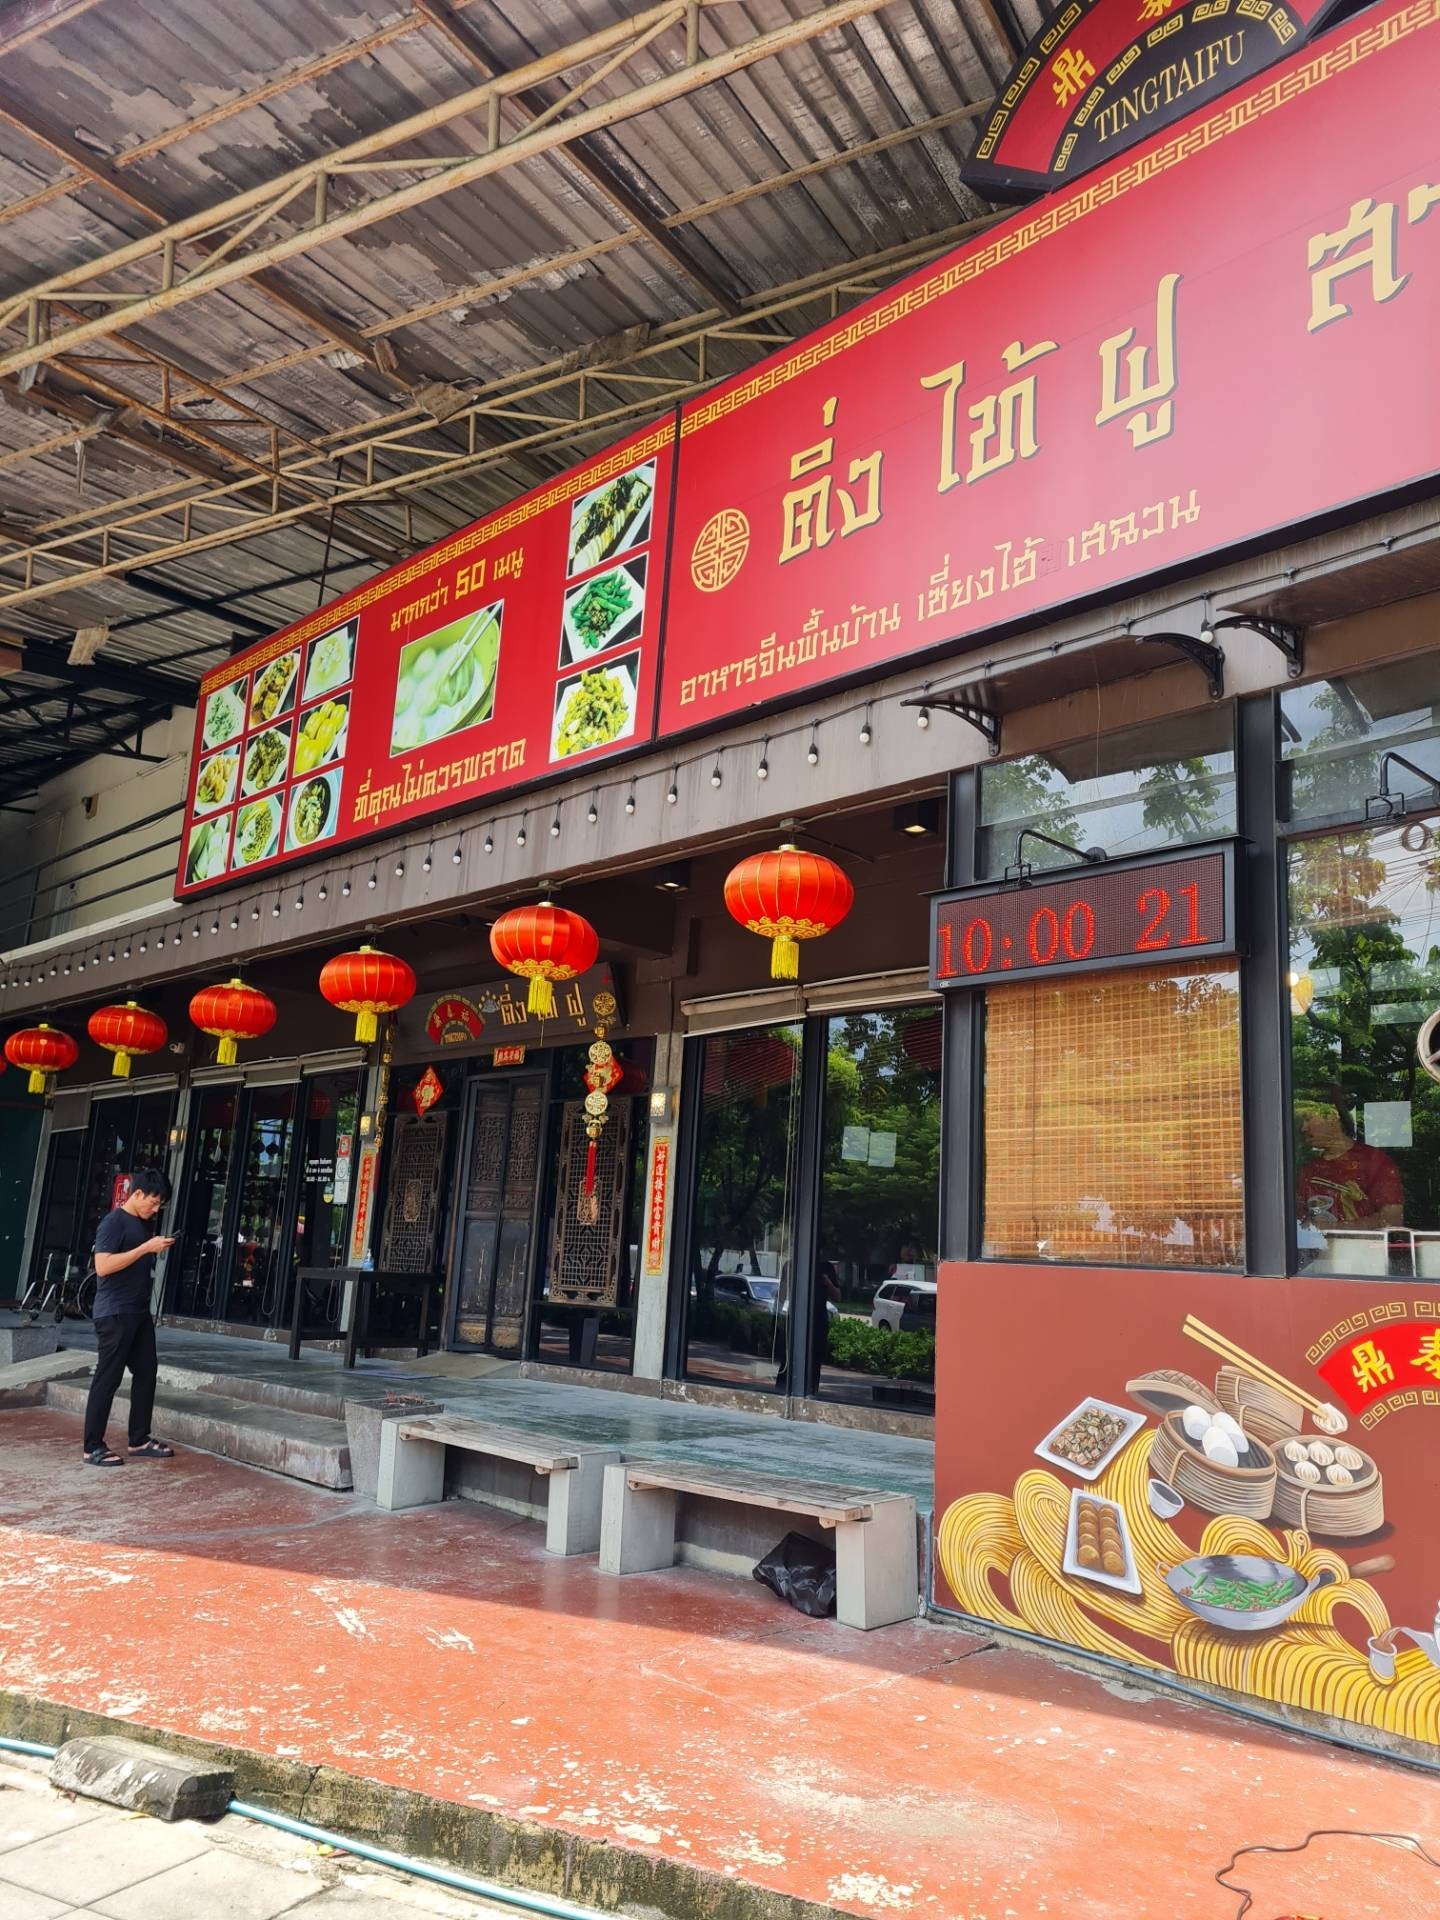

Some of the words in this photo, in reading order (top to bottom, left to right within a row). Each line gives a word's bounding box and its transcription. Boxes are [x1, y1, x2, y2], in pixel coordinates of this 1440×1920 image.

[1093, 30, 1246, 143] TINGTAIFU
[778, 396, 885, 565] ติ่ง
[920, 339, 1058, 495] ไท้
[390, 577, 449, 632] มากกว่า
[455, 558, 487, 600] 50
[492, 547, 524, 581] เมนู
[679, 601, 901, 706] อาหารจีนพื้นบ้าน
[917, 536, 1046, 622] เซี่ยงไฮ้
[1067, 489, 1201, 567] เสฉวน
[352, 737, 528, 826] ที่คุณไม่ควรพลาด
[937, 900, 1096, 979] 10:00
[1135, 882, 1209, 951] 21
